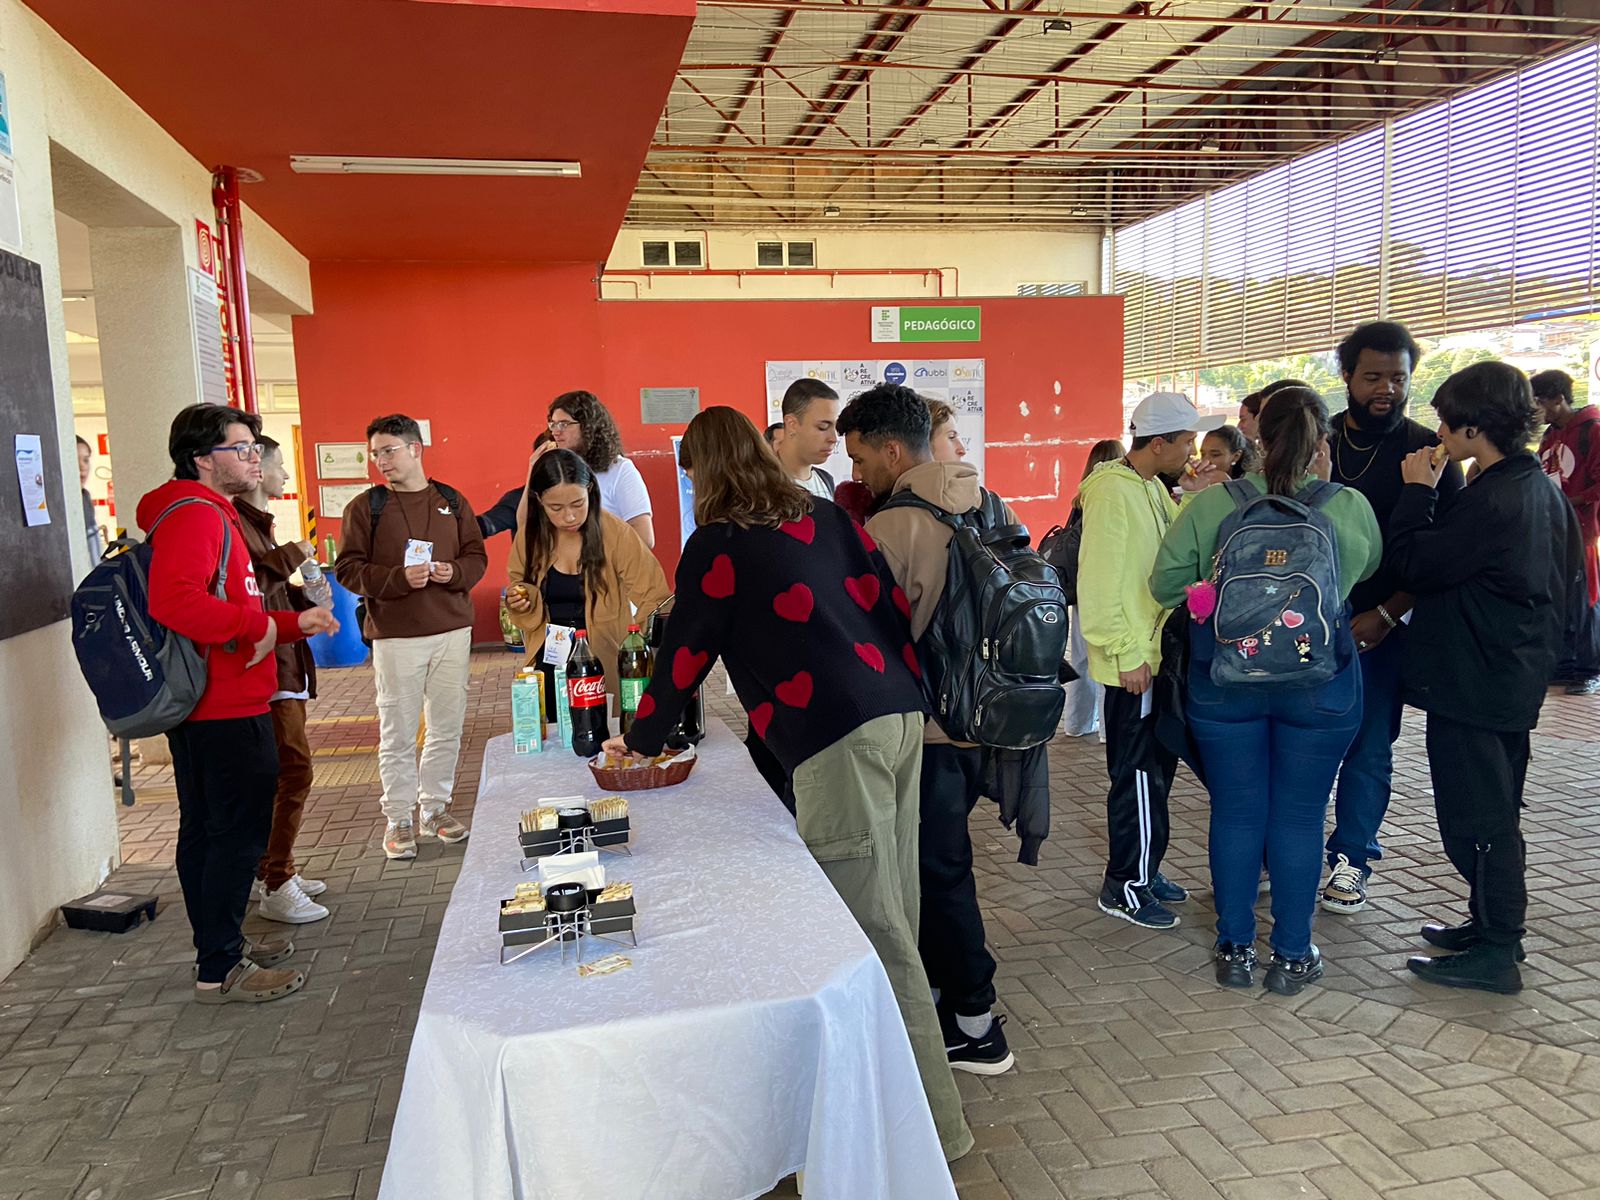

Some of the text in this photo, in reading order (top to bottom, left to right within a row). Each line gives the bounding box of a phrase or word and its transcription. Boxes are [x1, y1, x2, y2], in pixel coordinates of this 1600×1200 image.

[904, 318, 976, 331] PEDAGÓGICO
[126, 635, 154, 682] ARMOUR
[573, 675, 606, 697] Coca-Co
